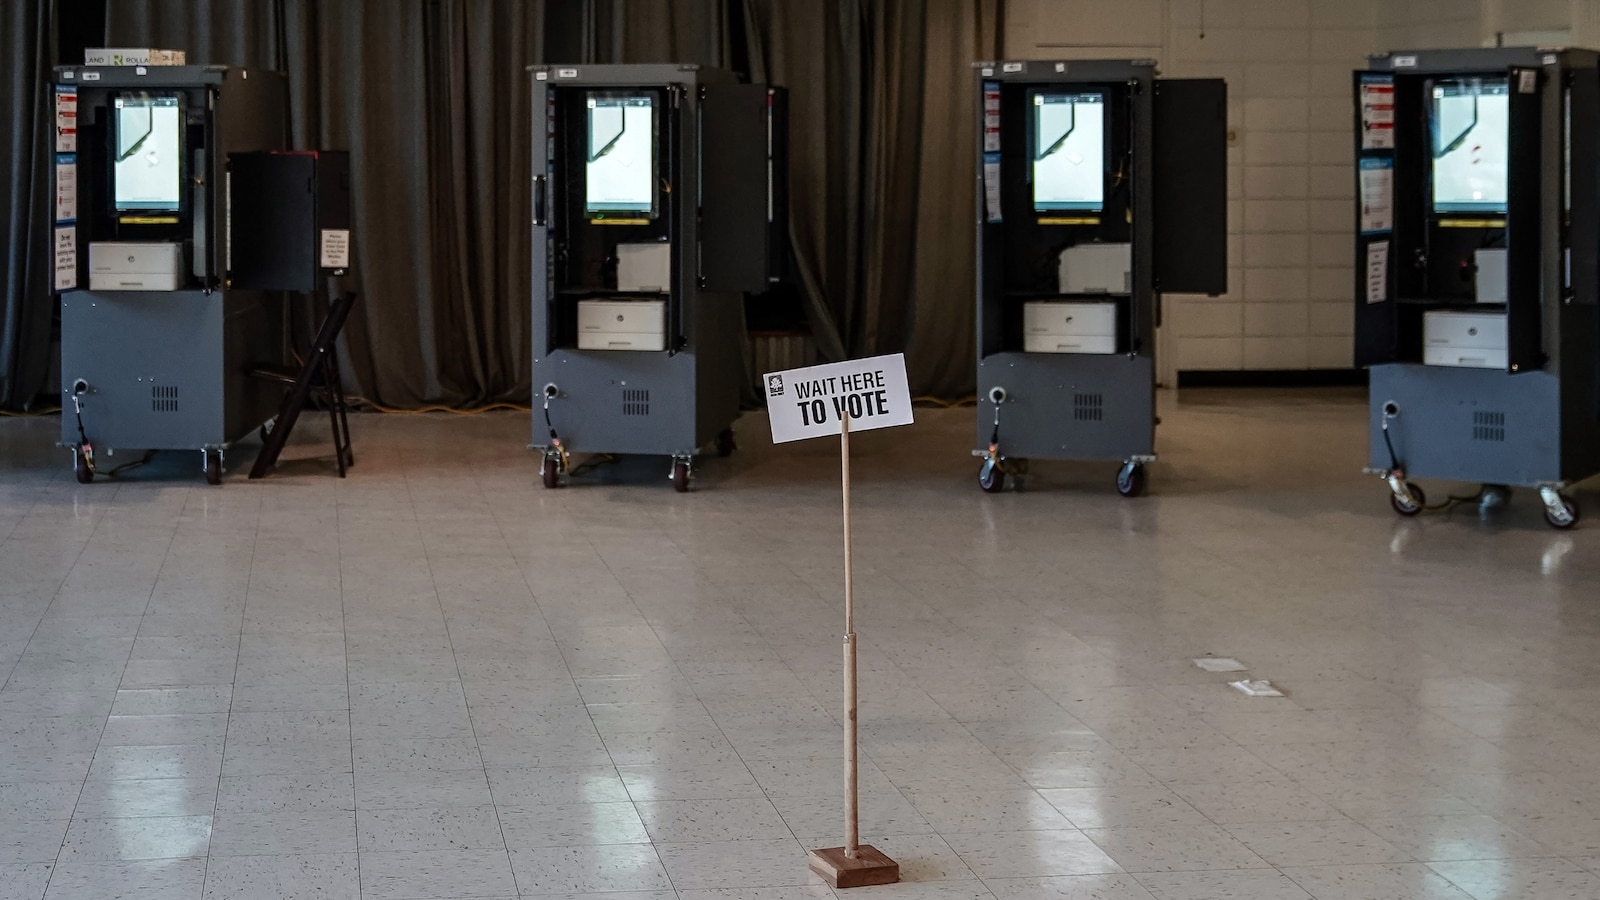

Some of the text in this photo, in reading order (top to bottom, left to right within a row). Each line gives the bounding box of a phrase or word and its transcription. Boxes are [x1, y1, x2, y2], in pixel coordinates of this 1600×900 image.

[794, 377, 837, 399] WAIT
[840, 370, 885, 392] HERE
[797, 389, 889, 426] TO VOTE
